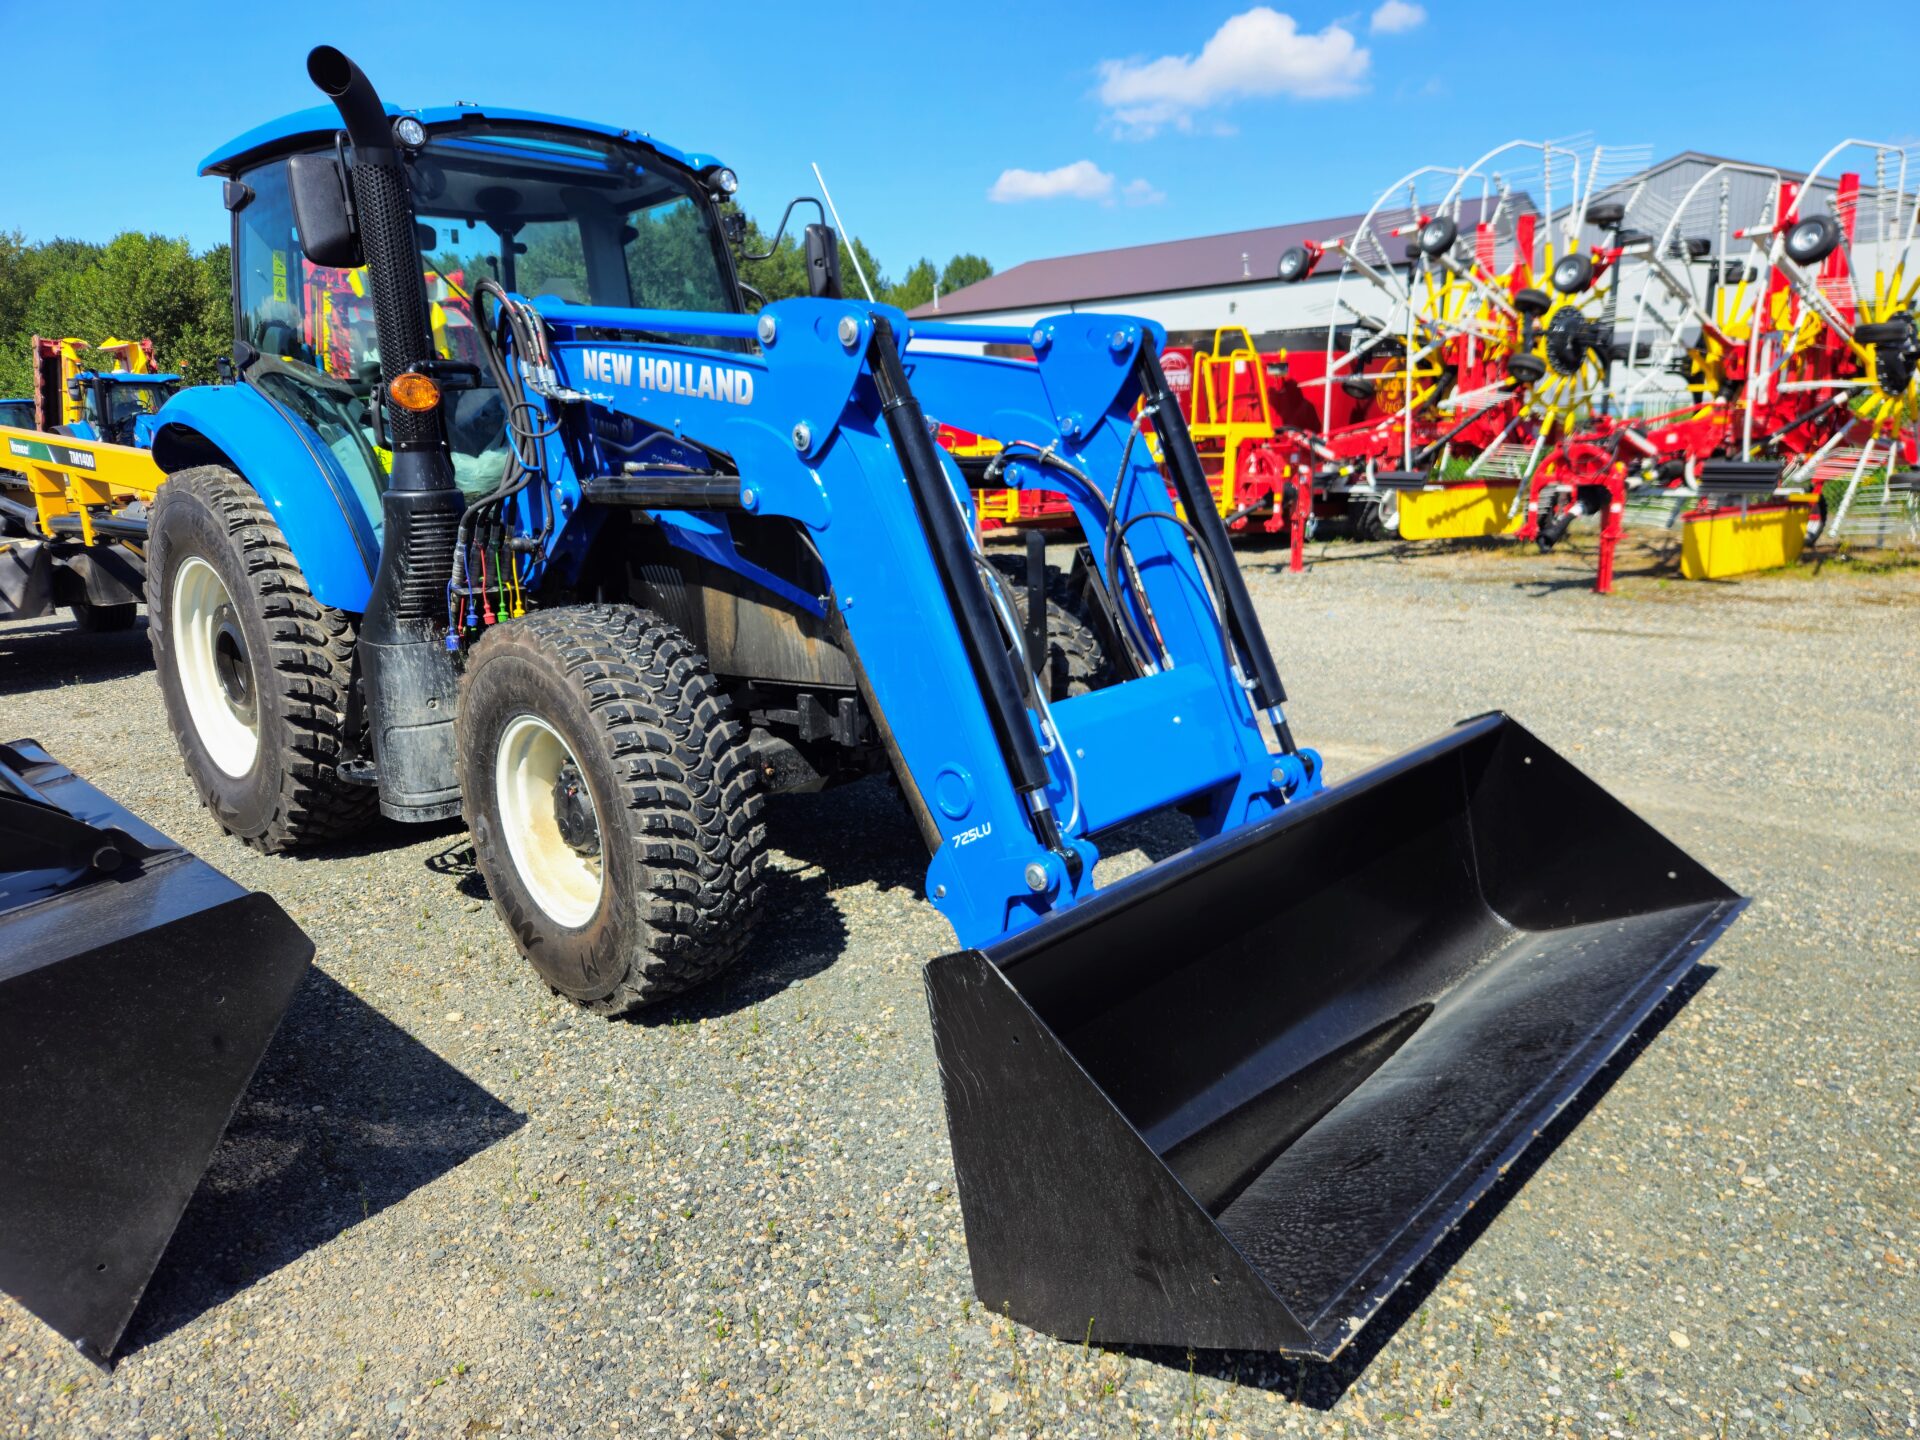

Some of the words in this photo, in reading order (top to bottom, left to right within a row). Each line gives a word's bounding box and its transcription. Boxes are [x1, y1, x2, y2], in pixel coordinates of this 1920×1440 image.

[582, 348, 632, 386] NEW
[639, 356, 754, 405] HOLLAND
[68, 450, 95, 468] TM1400
[952, 821, 992, 849] 725LU
